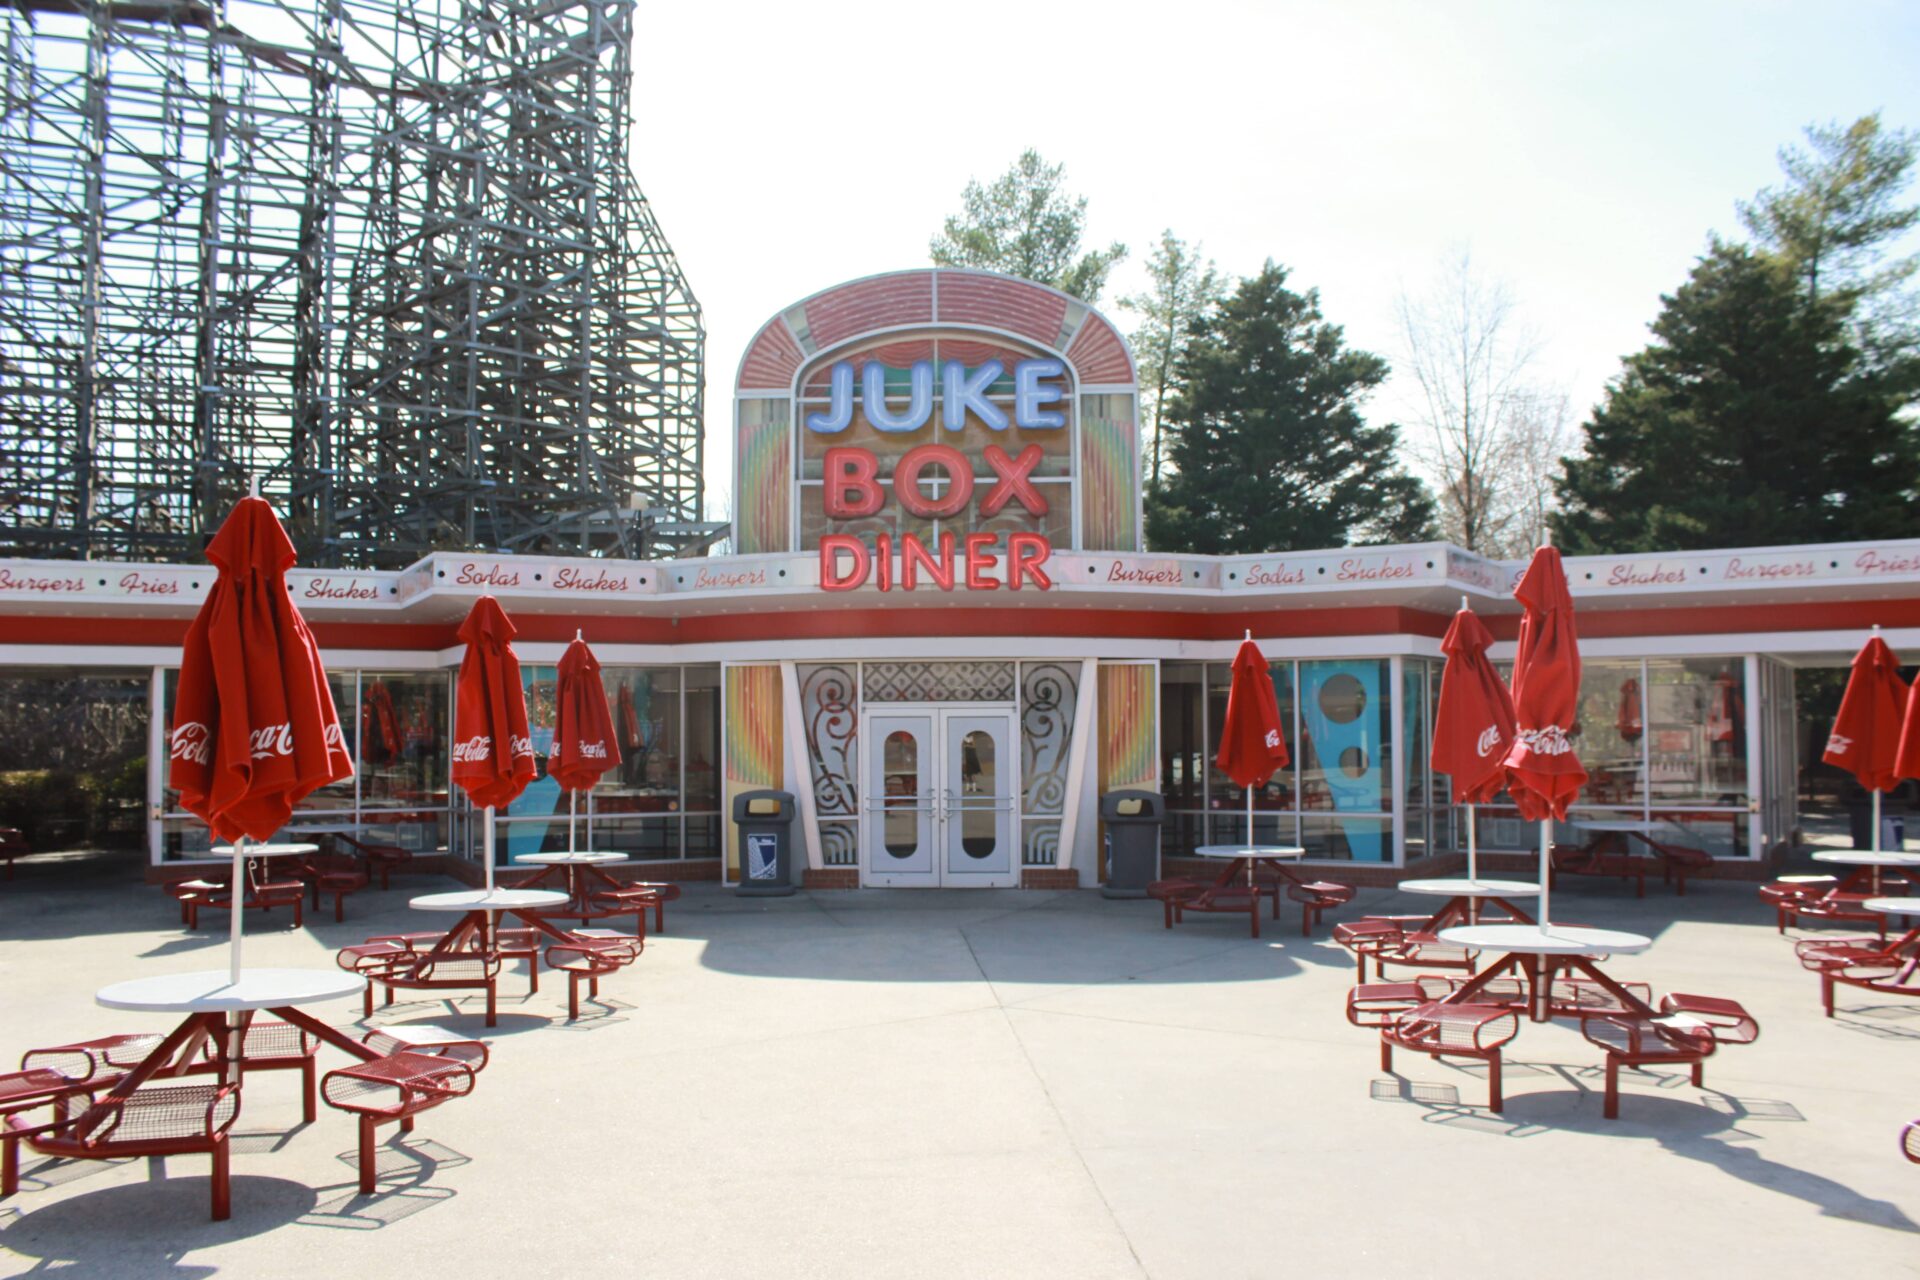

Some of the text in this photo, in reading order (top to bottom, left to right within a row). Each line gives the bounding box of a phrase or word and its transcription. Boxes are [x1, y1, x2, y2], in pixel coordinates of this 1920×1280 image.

[805, 358, 1066, 433] JUKE
[823, 443, 1050, 519] BOX
[456, 563, 520, 587] Sodas
[553, 568, 629, 591] Shakes
[819, 531, 1052, 592] DINER
[1107, 560, 1184, 584] Burgers
[1245, 557, 1415, 586] Sodas Shakes
[1607, 550, 1920, 586] Shakes Burgers Fries
[0, 569, 86, 592] Burgers
[119, 572, 179, 594] Fries
[304, 578, 379, 600] Shakes
[694, 567, 766, 589] Burgers
